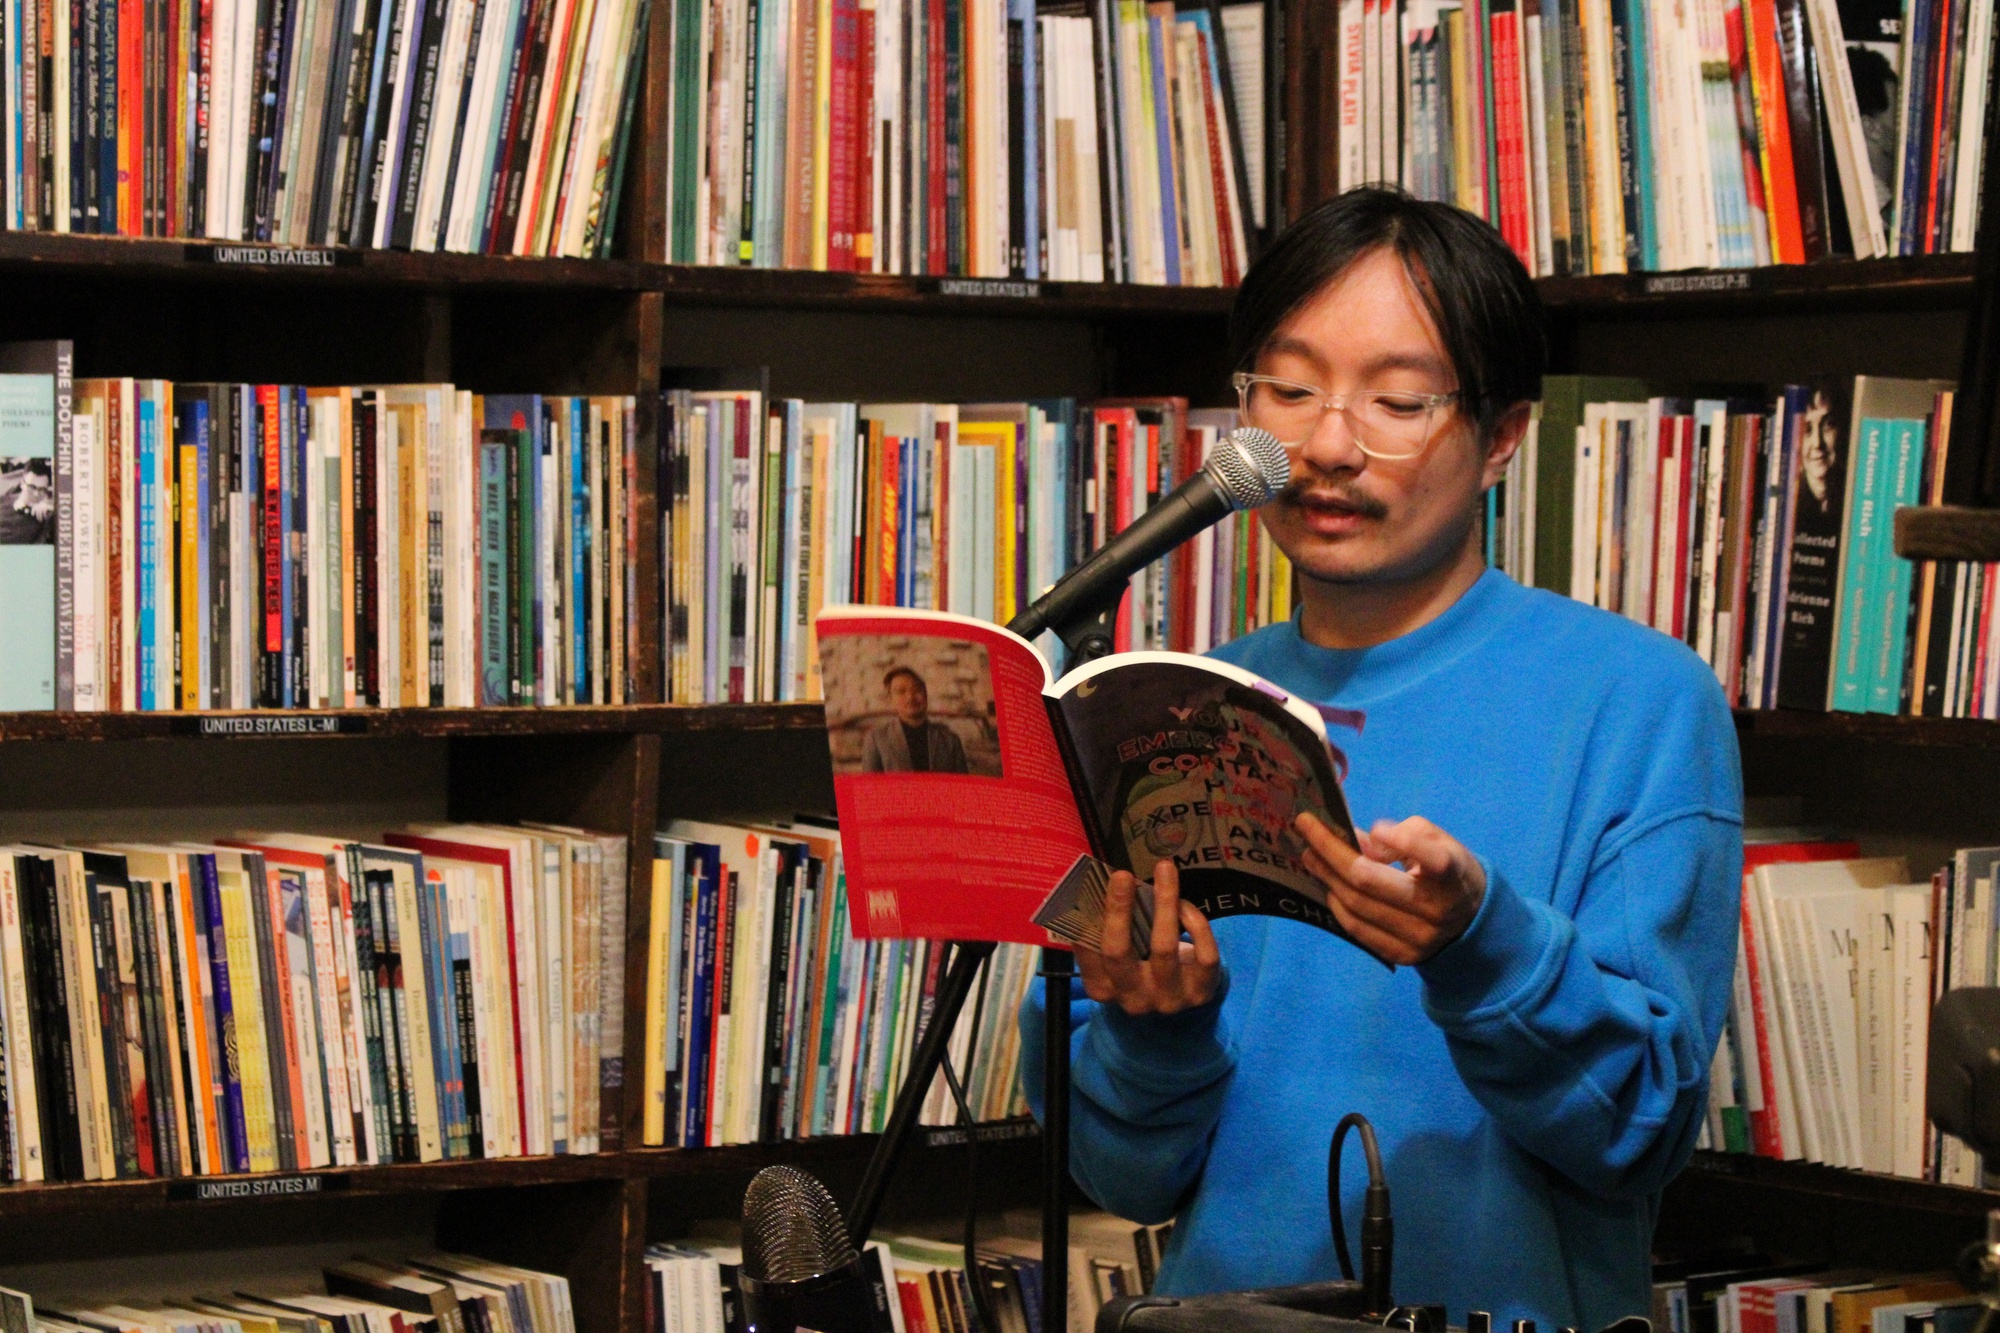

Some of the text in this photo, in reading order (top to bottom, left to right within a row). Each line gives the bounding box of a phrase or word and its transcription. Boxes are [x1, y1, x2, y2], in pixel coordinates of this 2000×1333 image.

[427, 45, 438, 68] THE
[803, 26, 816, 76] MILES
[25, 70, 36, 97] THE
[105, 65, 115, 78] IN
[1343, 23, 1362, 126] SYLVIA PLATH
[105, 83, 115, 104] THE
[199, 38, 211, 149] THE CARRYING
[421, 71, 434, 102] SONG
[414, 122, 426, 145] THE
[218, 248, 331, 265] UNITED STATES L
[942, 281, 1038, 297] UNITED STATES M
[1649, 277, 1685, 292] UNITED
[1686, 275, 1725, 290] STATES
[266, 390, 279, 455] THOMAS
[266, 457, 279, 486] LUX
[1896, 429, 1911, 496] Adrienne
[1860, 429, 1880, 537] Adrienne Rich
[57, 353, 73, 659] THE DOLPHIN ROBERT LOWELL
[78, 423, 90, 573] ROBERT LOWELL
[328, 500, 341, 611] Hours of the Cardinal
[799, 486, 813, 626] Escape of the Leopard
[1791, 611, 1815, 625] Rich
[204, 718, 335, 733] UNITED STATES L-M
[1229, 825, 1273, 845] AN
[2, 870, 13, 891] Paul
[402, 881, 413, 920] Ludlow
[201, 1177, 318, 1198] UNITED STATES M
